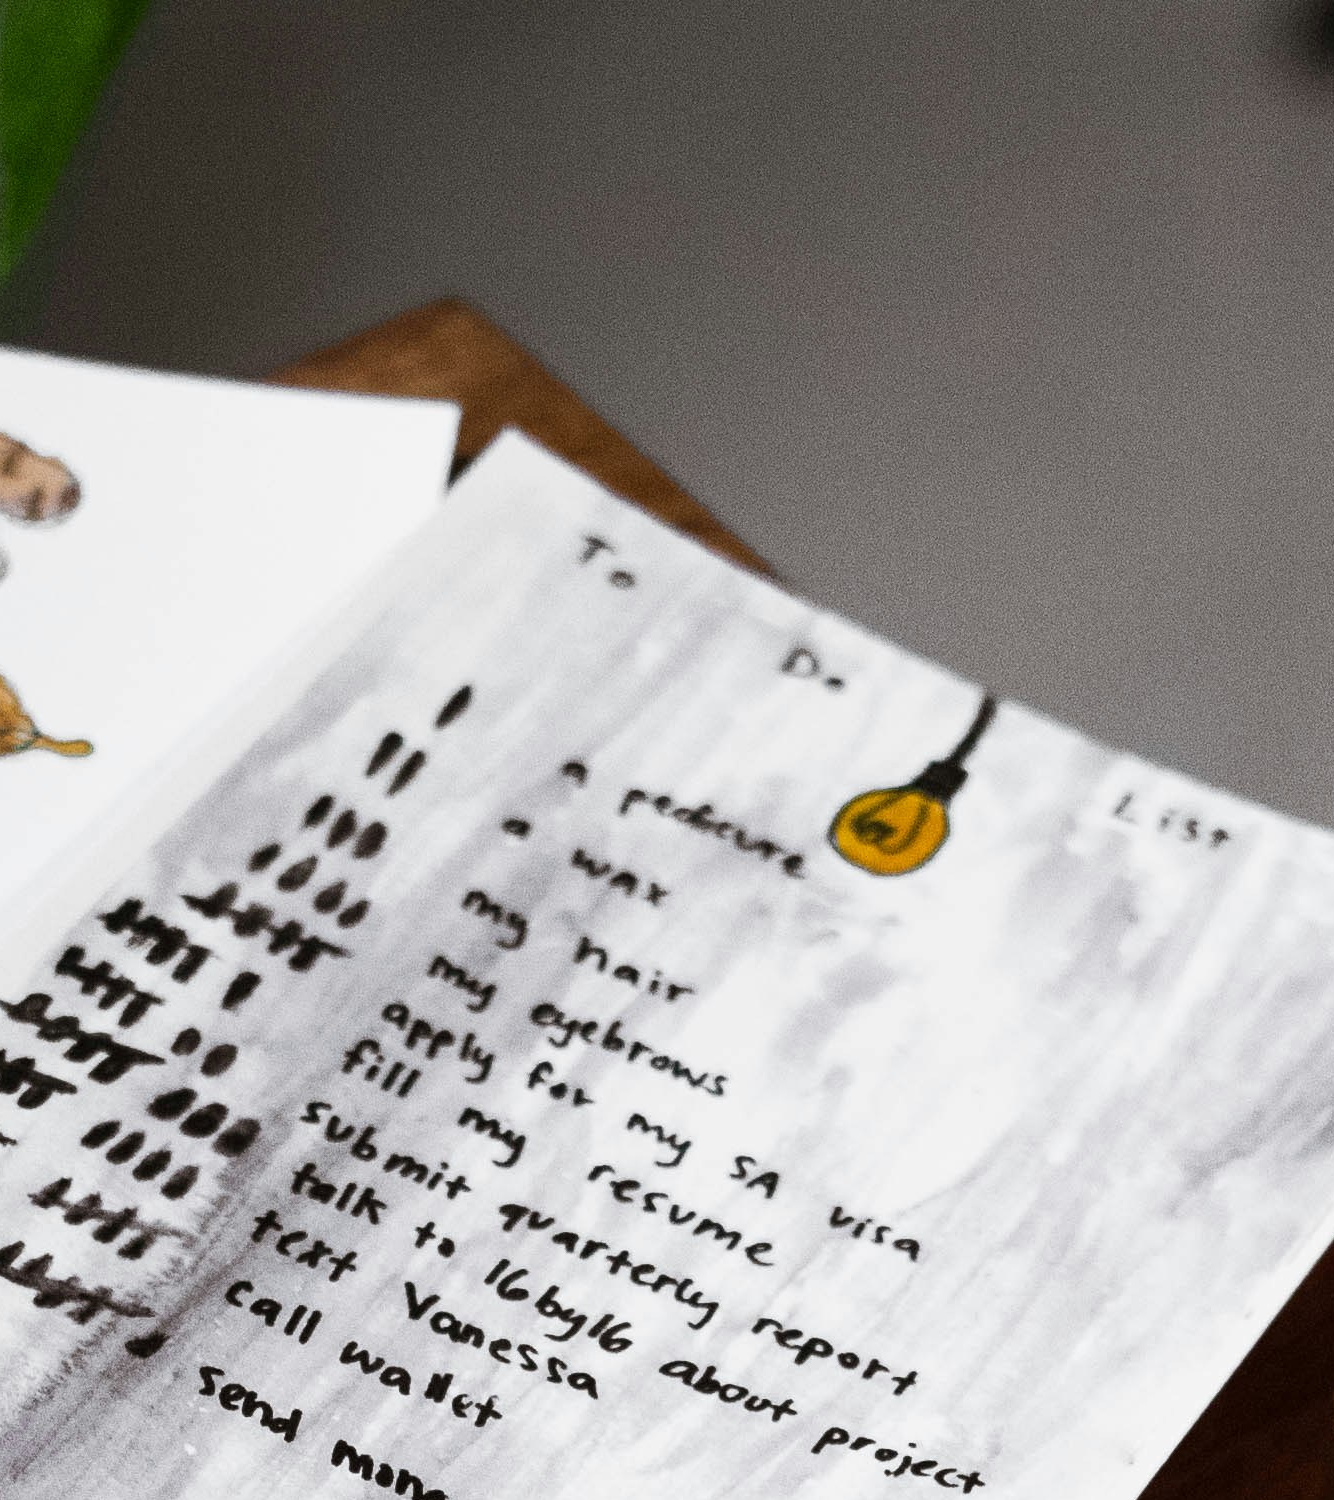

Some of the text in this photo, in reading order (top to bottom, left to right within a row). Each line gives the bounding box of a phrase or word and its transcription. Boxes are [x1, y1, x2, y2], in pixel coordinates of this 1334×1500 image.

[583, 536, 1231, 850] To Do List
[500, 816, 669, 906] a wax
[560, 760, 806, 880] a pedicure
[428, 953, 728, 1096] my eyebrows
[463, 889, 698, 1002] my hair
[341, 1039, 777, 1268] fill my resume
[381, 1001, 923, 1264] apply for my SA visa
[250, 1210, 601, 1400] text Vanessa
[290, 1160, 988, 1498] talk to 16by16 about project
[300, 1098, 920, 1398] submit quarterly report
[199, 1365, 304, 1443] send
[225, 1277, 504, 1428] call wallet
